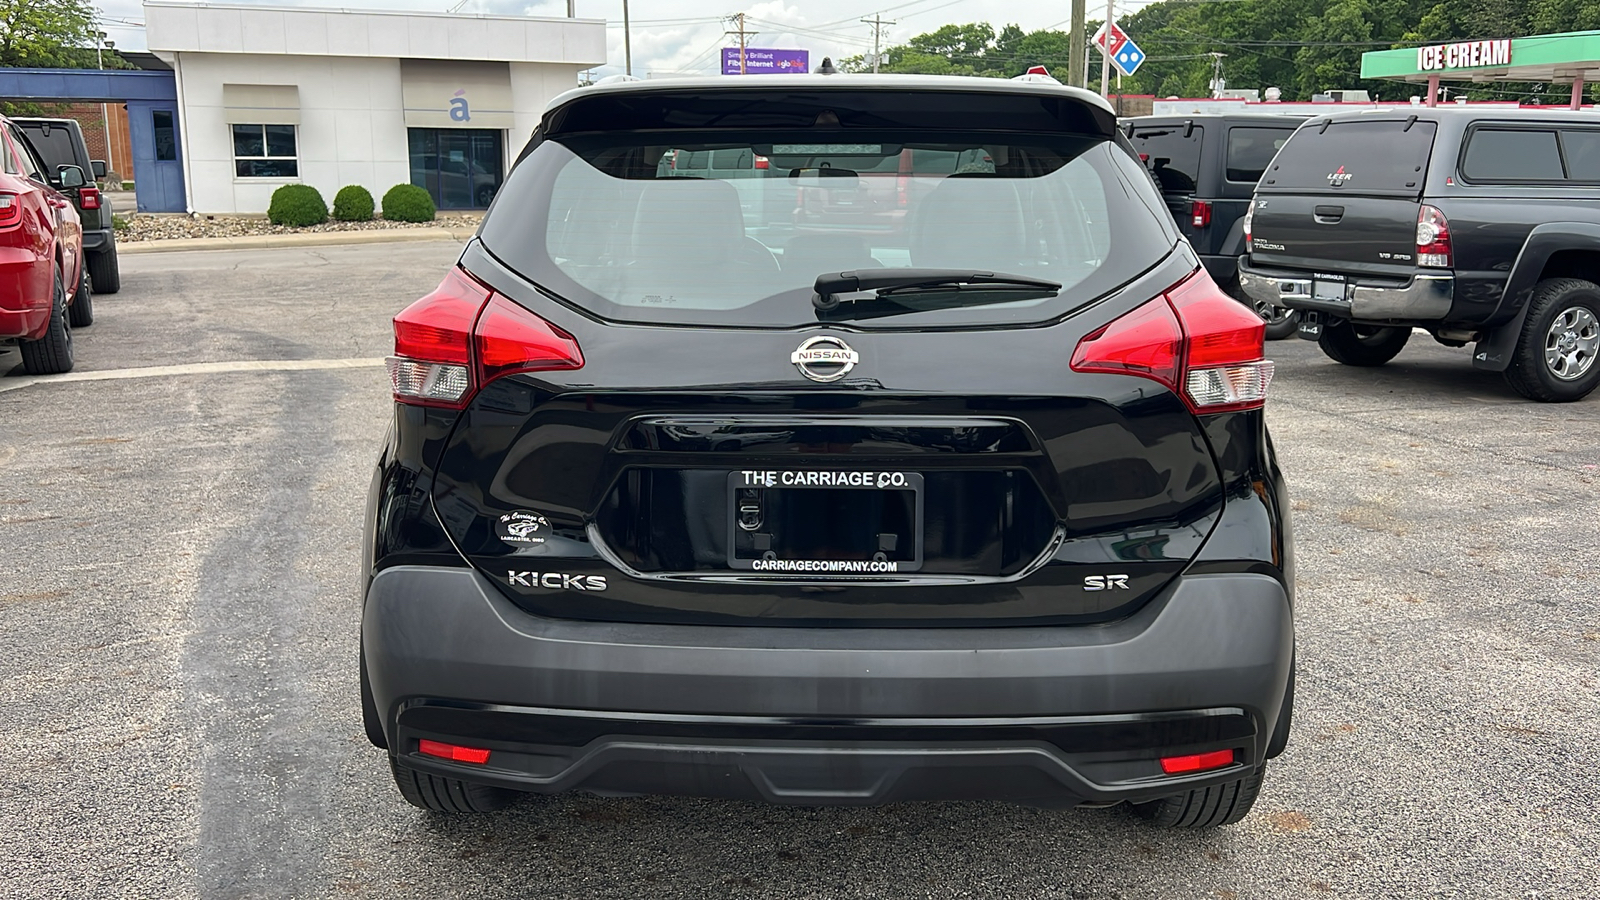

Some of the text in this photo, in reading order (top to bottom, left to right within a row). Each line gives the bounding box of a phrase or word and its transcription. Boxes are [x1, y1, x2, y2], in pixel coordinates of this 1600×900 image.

[1417, 39, 1512, 71] ICE CREAM
[746, 60, 774, 68] Internet
[1326, 173, 1353, 181] LEER
[798, 350, 852, 361] NISSAN
[741, 470, 909, 488] THE CARRIAGE CO.
[752, 560, 898, 572] CARRIAGECOMPANY.COM
[508, 570, 607, 591] KICKS
[1083, 574, 1130, 592] SR
